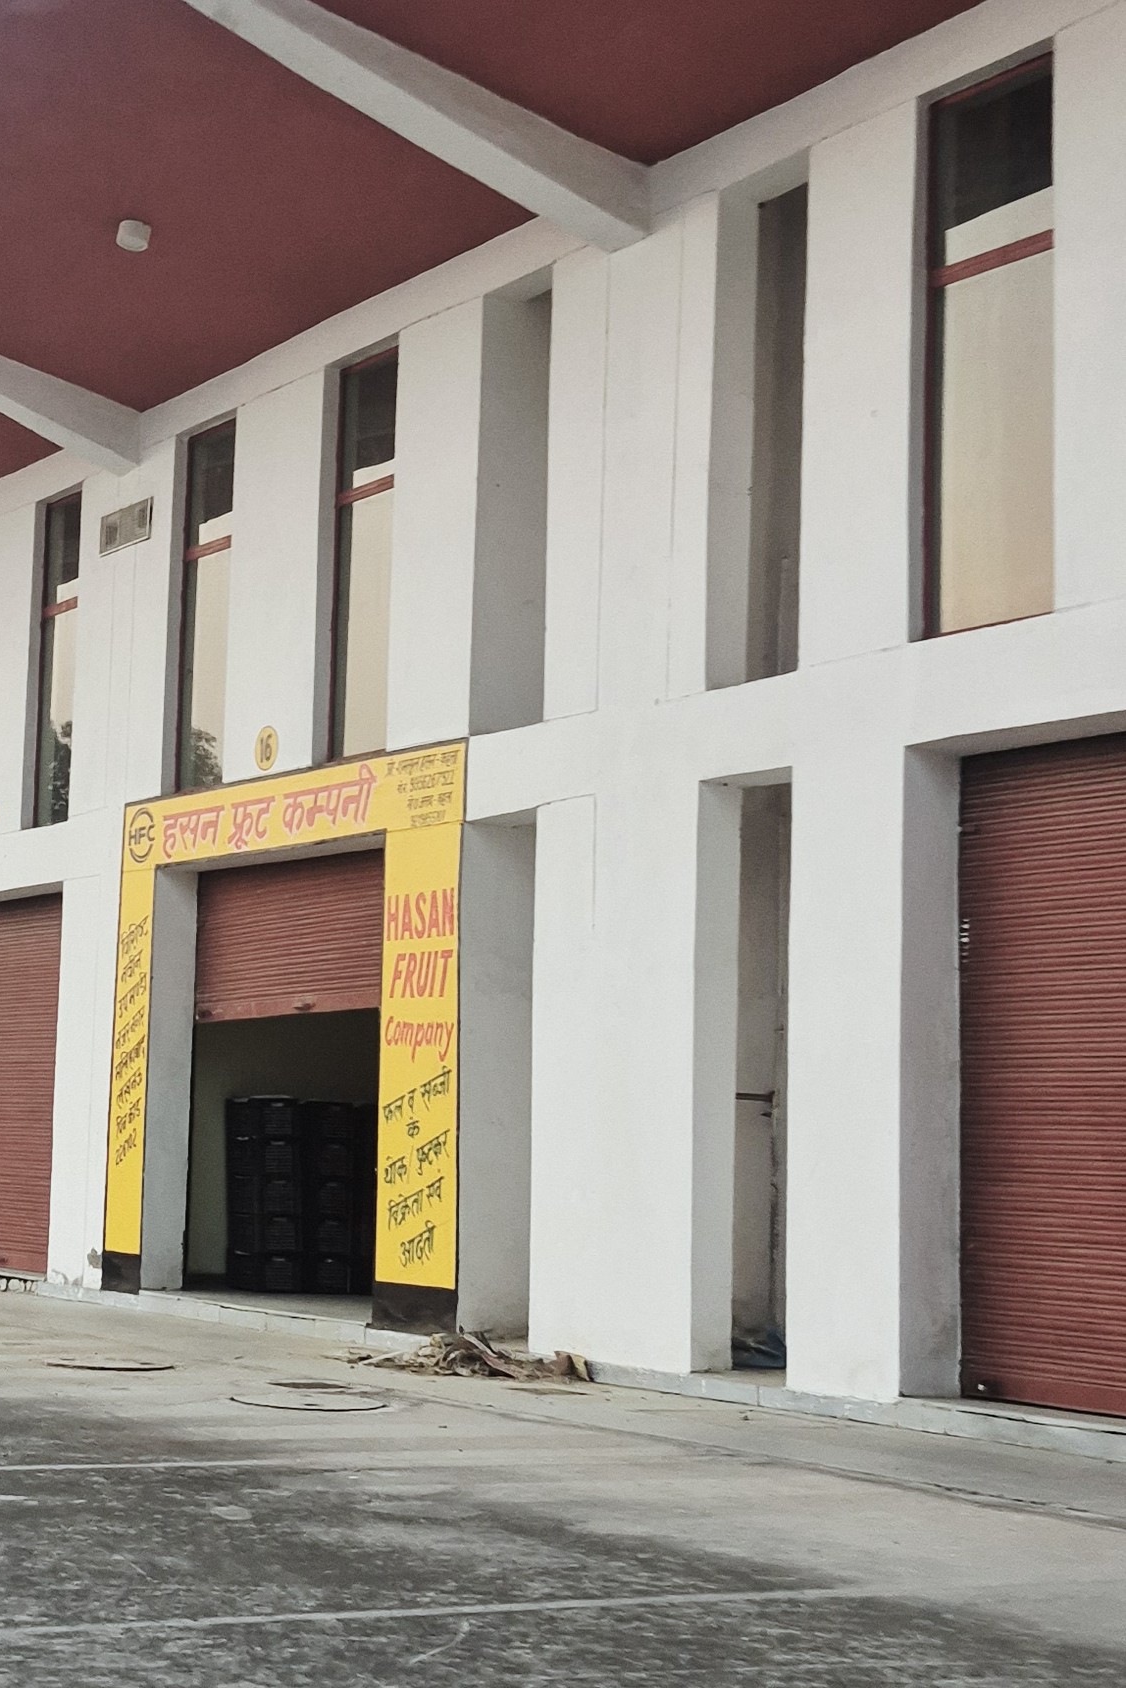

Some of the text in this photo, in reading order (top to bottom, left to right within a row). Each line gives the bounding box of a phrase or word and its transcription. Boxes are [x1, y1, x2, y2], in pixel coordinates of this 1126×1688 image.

[128, 818, 156, 848] HFC
[162, 804, 225, 860] हसन
[227, 799, 275, 853] फ्रूट
[282, 763, 378, 835] कम्पनी
[385, 887, 455, 942] HASAN
[388, 949, 454, 999] FRUIT
[381, 1094, 407, 1125] फल
[407, 1087, 417, 1114] व
